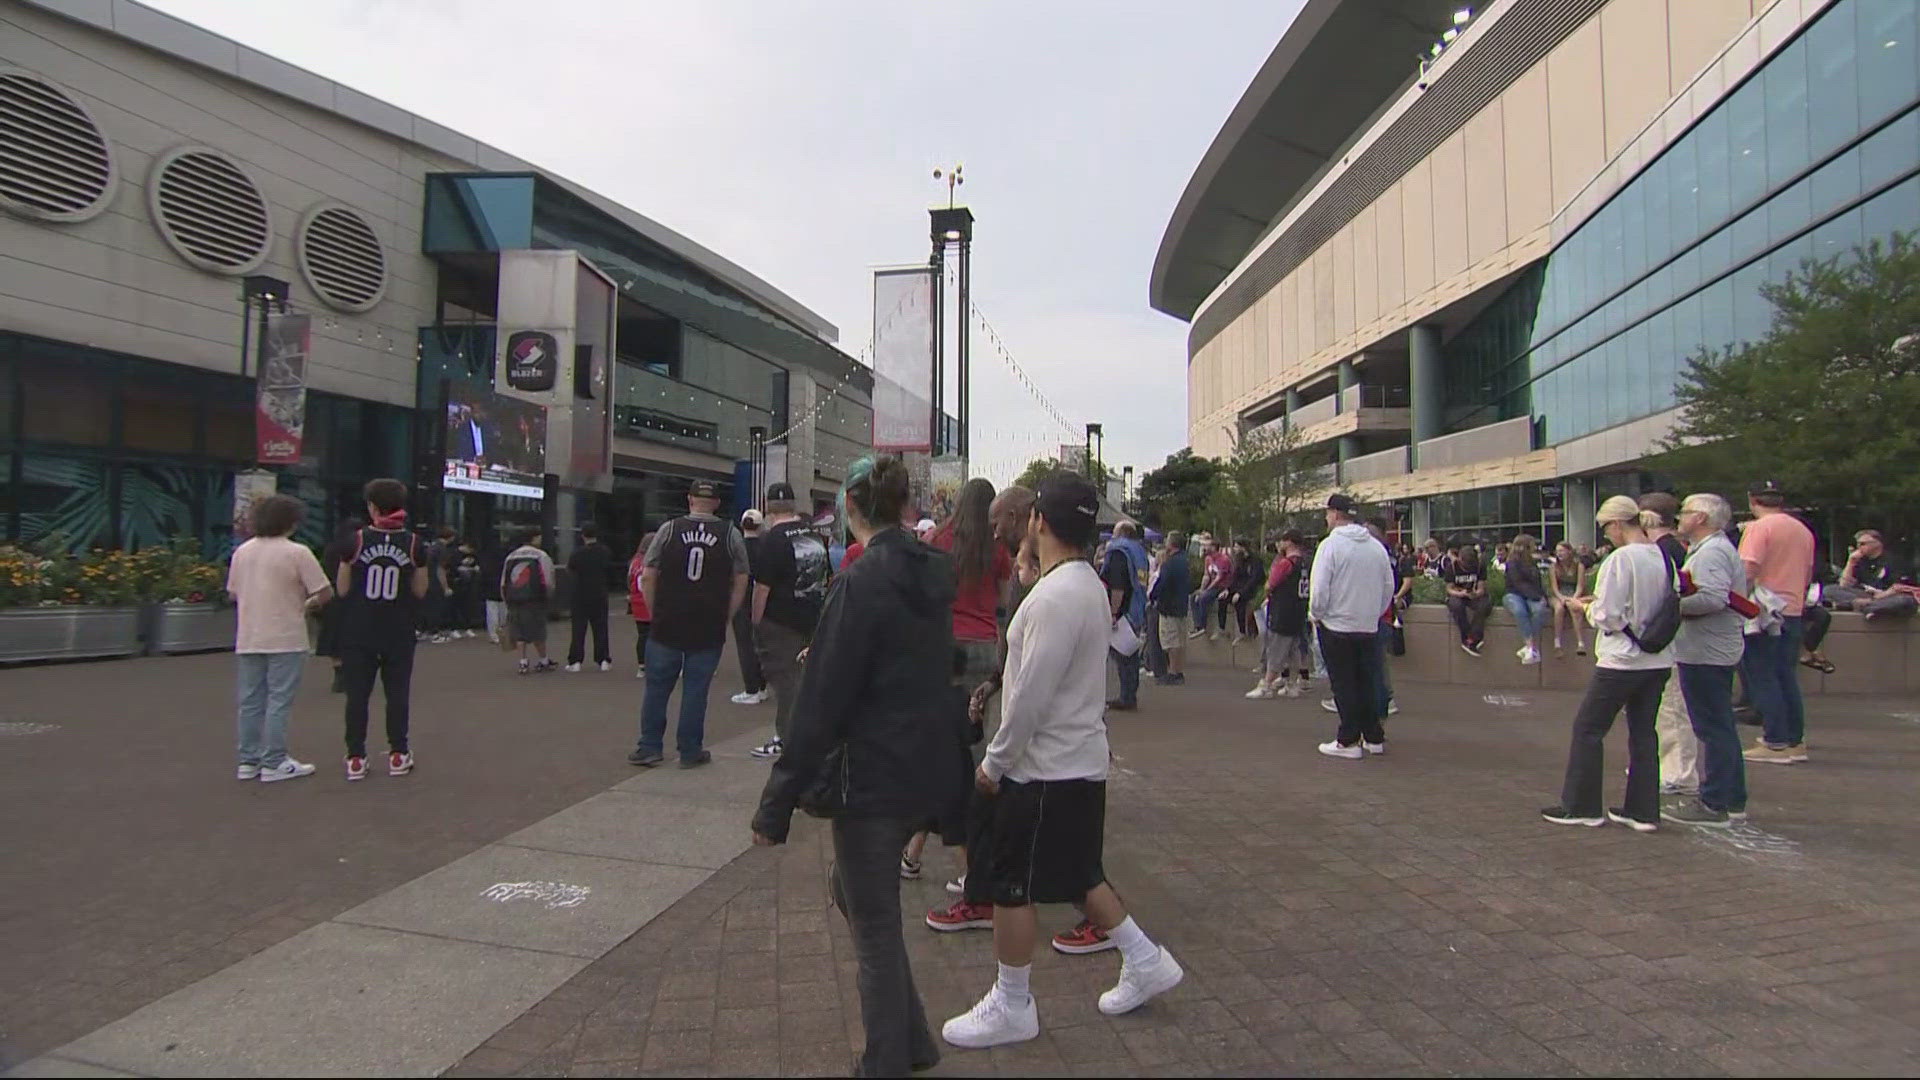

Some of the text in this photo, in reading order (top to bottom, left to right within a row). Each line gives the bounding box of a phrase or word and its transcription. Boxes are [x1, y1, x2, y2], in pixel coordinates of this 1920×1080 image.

[681, 530, 718, 547] LILLARD
[360, 543, 411, 567] HENDERSON
[687, 546, 704, 581] 0
[366, 564, 400, 600] 00
